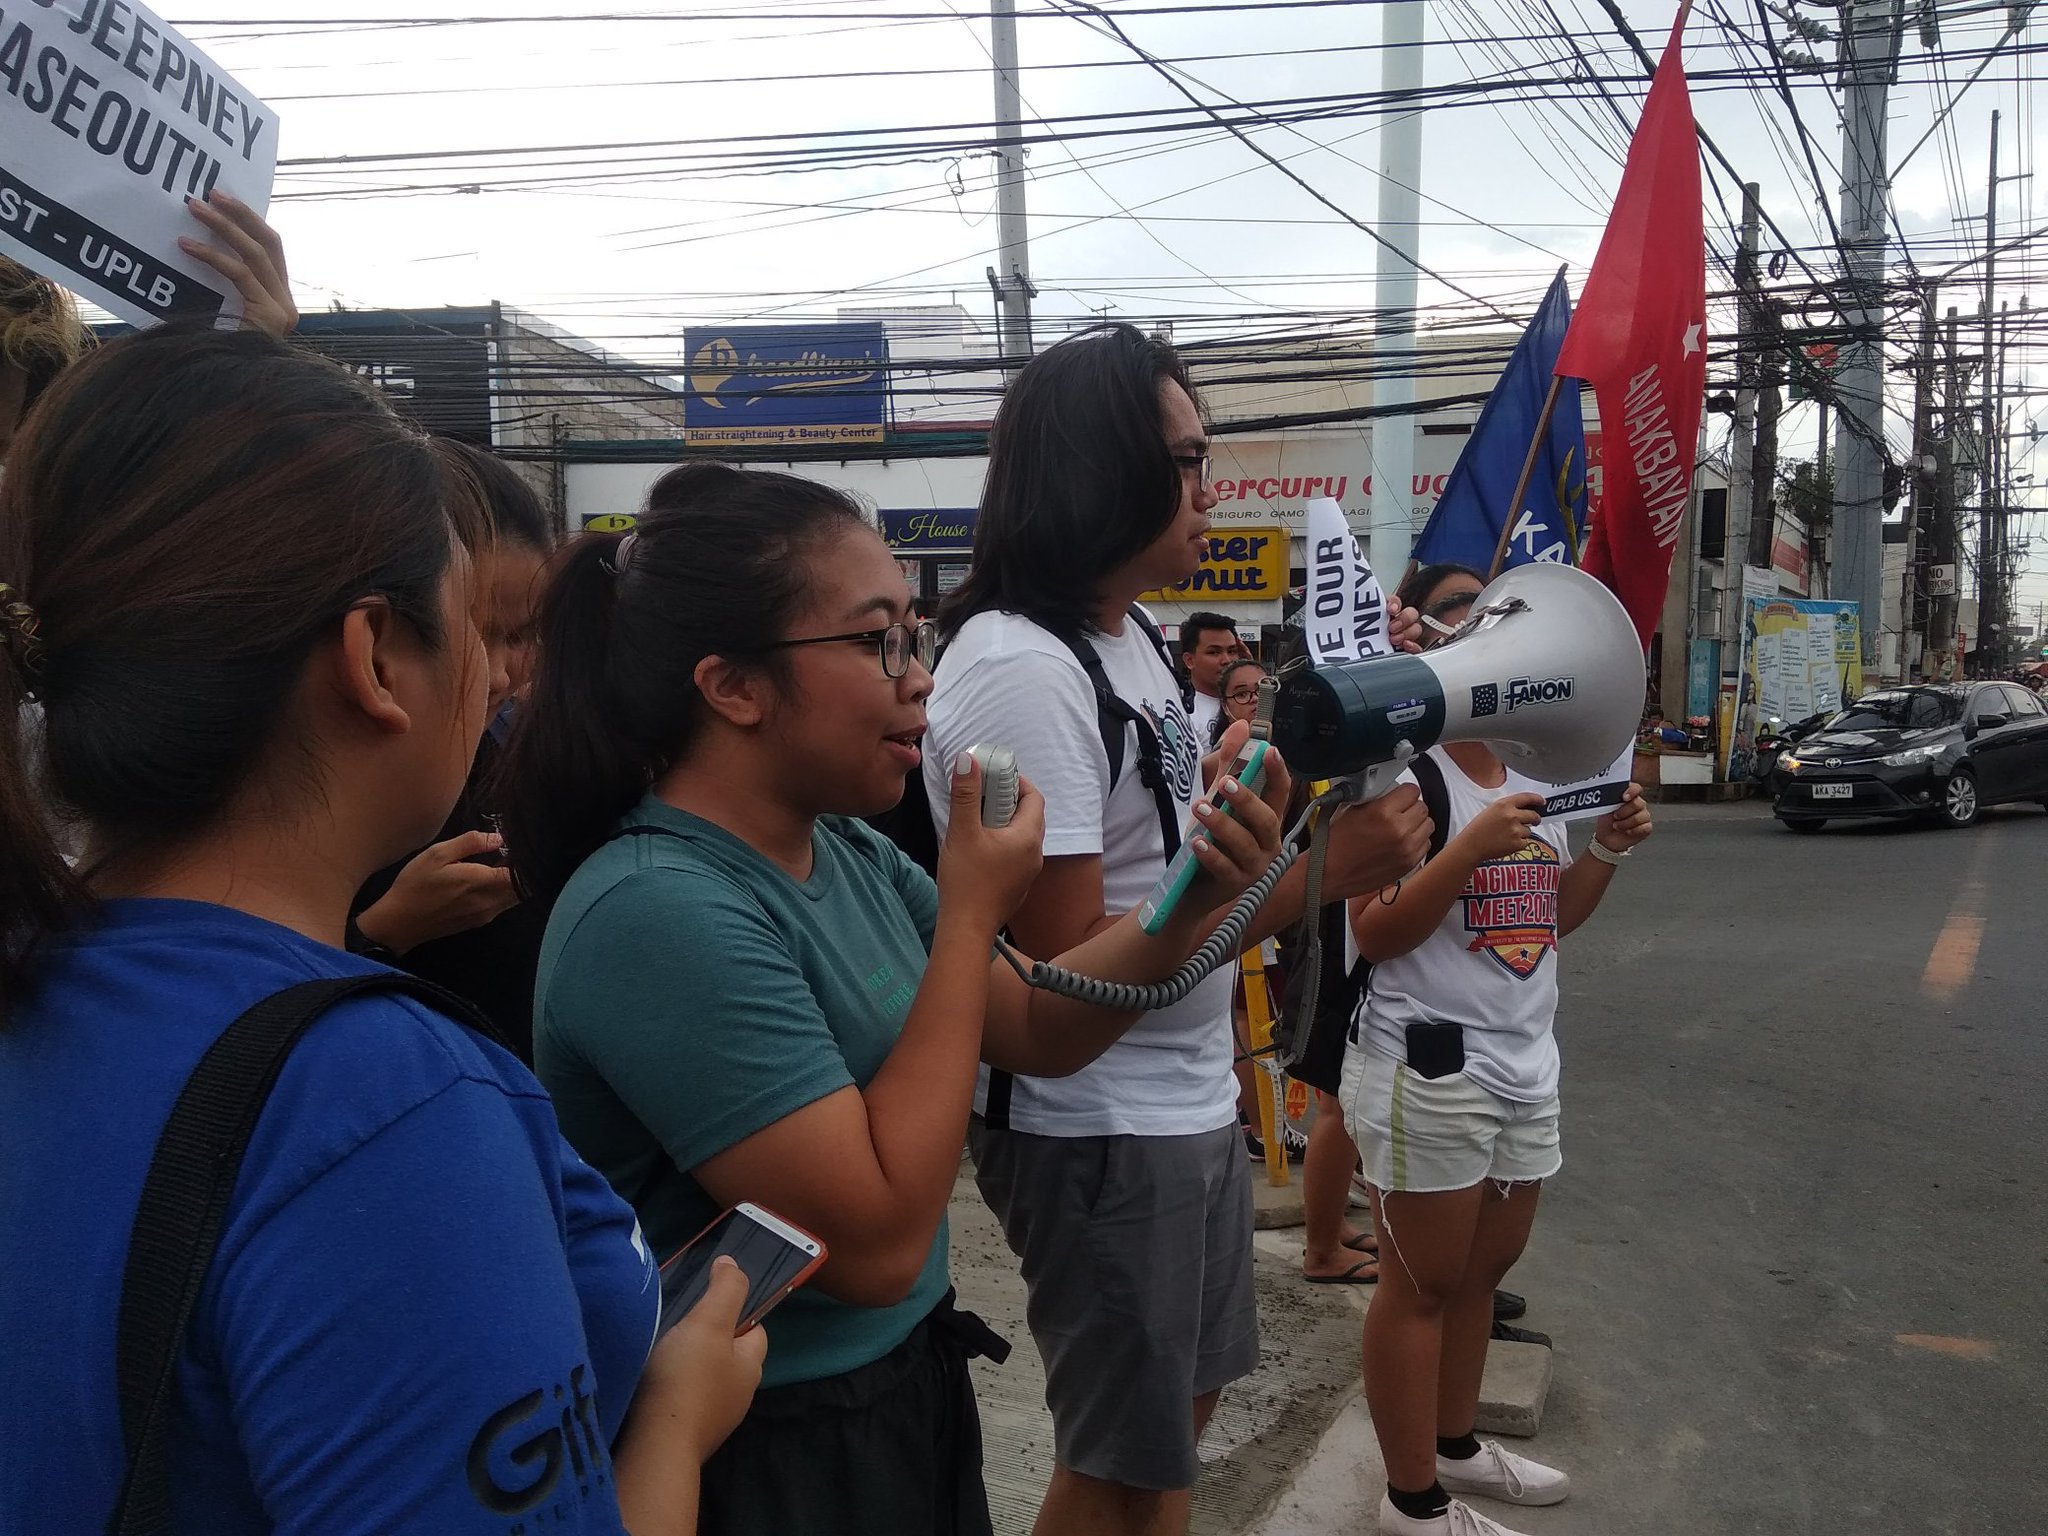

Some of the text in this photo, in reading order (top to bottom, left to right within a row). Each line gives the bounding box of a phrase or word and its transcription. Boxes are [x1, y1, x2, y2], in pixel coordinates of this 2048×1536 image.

[67, 0, 264, 162] JEEPNEY
[0, 8, 222, 205] ASEOUT!!
[0, 187, 49, 234] ST
[79, 234, 177, 308] UPLB
[690, 427, 878, 442] Hair straightening & Beauty Center
[1623, 362, 1689, 548] ANAKBAYAN
[1214, 474, 1348, 502] ercury
[1206, 506, 1430, 519] SISIGURO GAMO LAGI GO
[897, 513, 969, 542] House
[1200, 537, 1268, 562] ter
[1177, 567, 1268, 591] nut
[1314, 536, 1345, 619] OUR
[1928, 578, 1954, 590] RKING
[1546, 789, 1601, 813] UPLB USC
